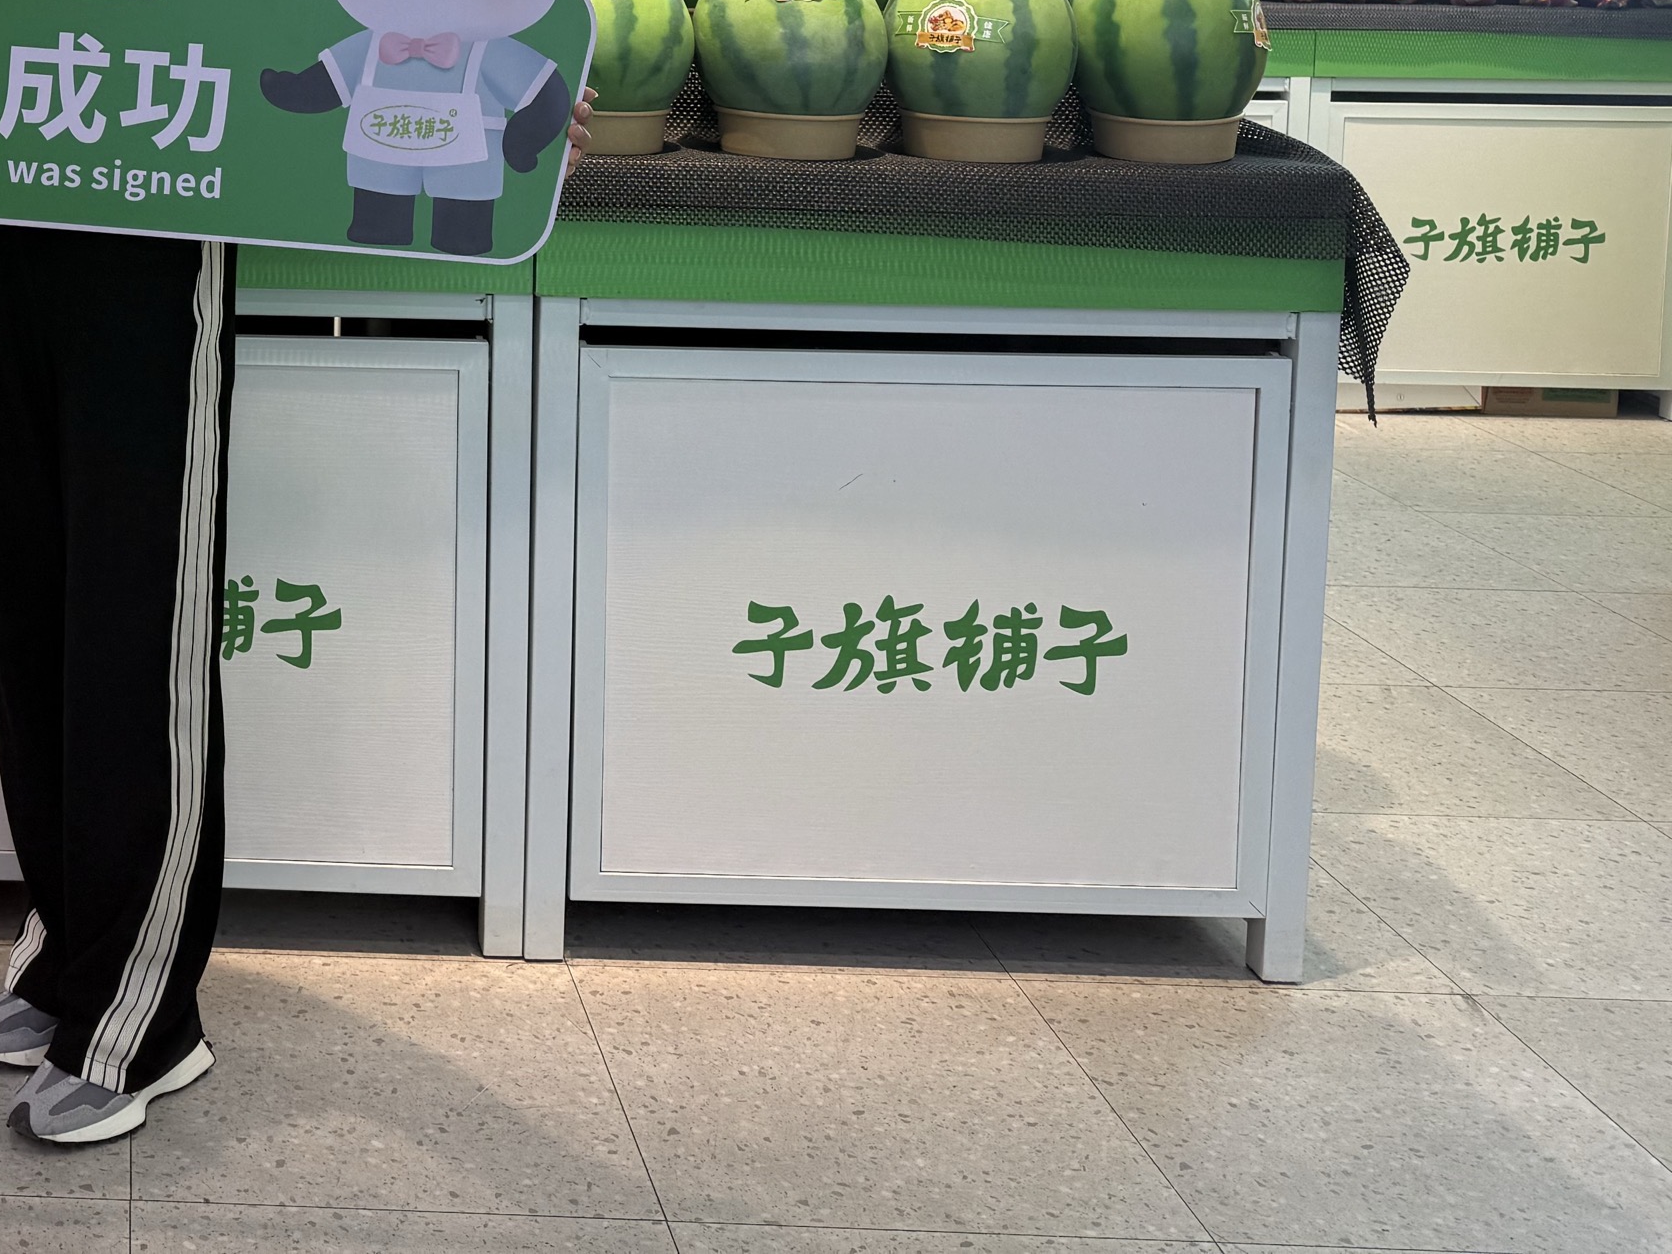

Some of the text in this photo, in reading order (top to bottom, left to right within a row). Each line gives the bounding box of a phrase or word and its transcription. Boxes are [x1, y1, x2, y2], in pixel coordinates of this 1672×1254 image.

[369, 112, 455, 143] 子旗铺子
[7, 160, 82, 190] was
[91, 159, 223, 202] signed
[1403, 213, 1606, 264] 子旗铺子
[731, 593, 1129, 697] 子旗铺子
